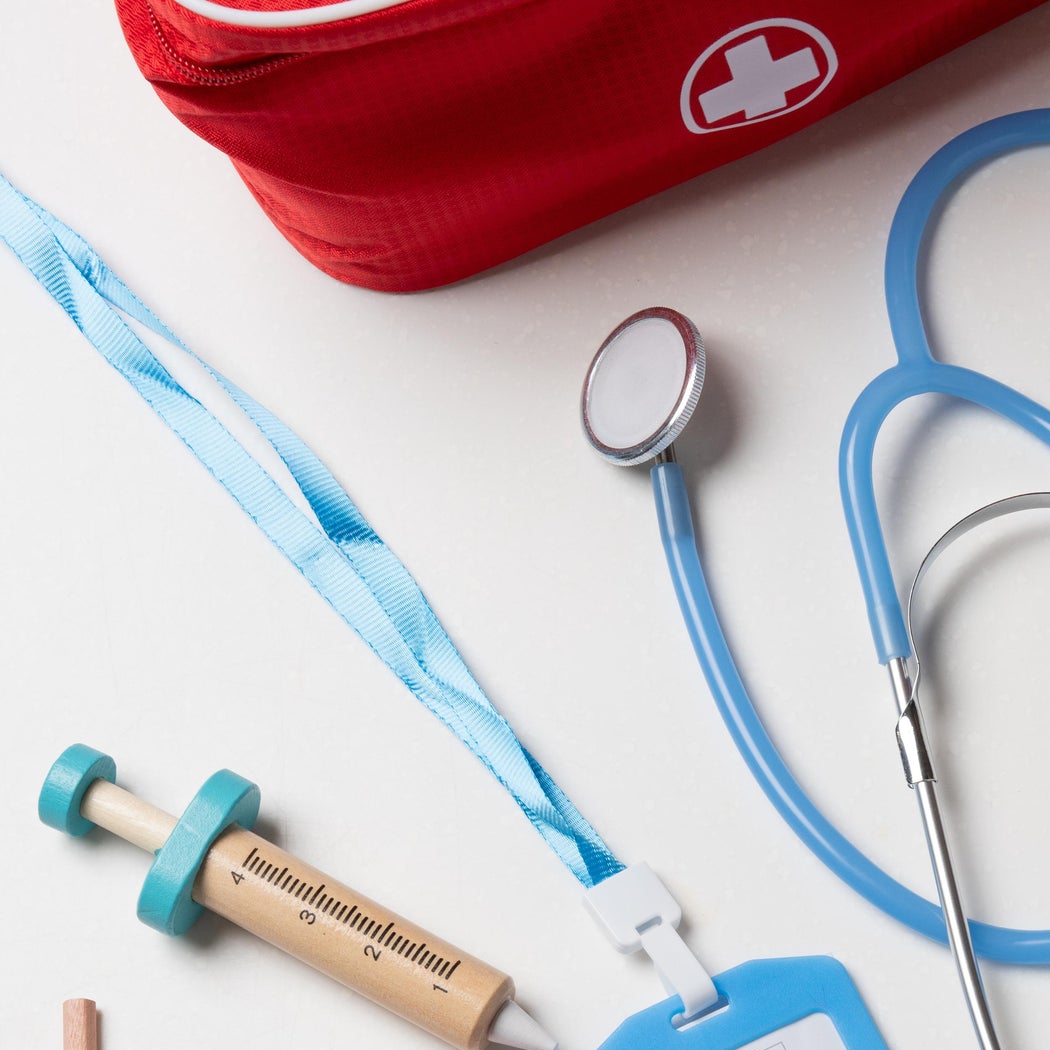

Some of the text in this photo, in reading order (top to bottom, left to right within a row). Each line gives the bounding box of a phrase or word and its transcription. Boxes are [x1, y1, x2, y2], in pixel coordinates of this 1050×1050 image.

[230, 868, 246, 885] 4
[299, 909, 317, 925] 3
[363, 944, 382, 962] 2
[432, 983, 449, 994] 1
